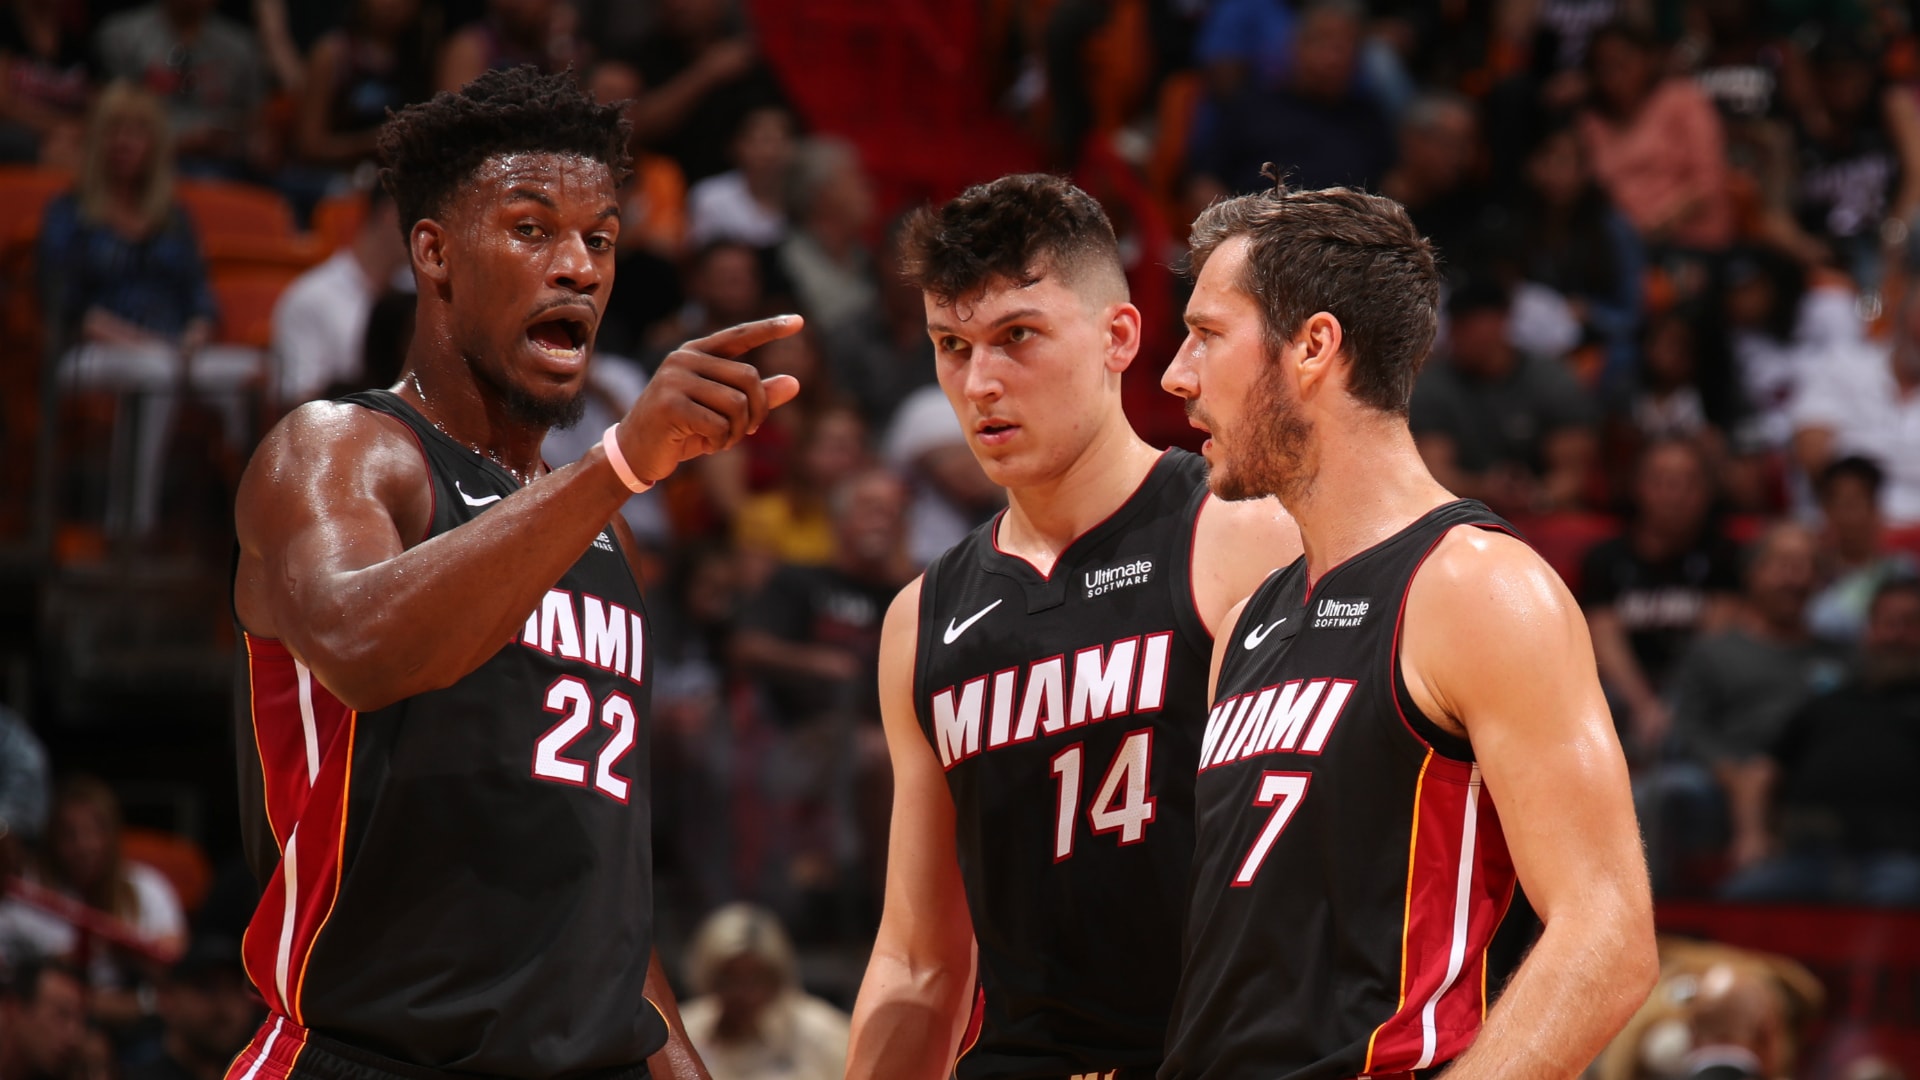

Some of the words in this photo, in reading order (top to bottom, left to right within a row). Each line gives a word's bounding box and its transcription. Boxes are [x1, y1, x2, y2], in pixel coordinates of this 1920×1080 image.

[1085, 560, 1153, 588] Ultimate
[1087, 574, 1149, 598] SOFTWARE
[1314, 617, 1363, 628] SOFTWARE
[1317, 599, 1369, 617] Ultimate
[509, 587, 644, 687] IAMI
[531, 674, 639, 806] 22
[931, 630, 1174, 772] MIAMI
[1197, 677, 1358, 776] MIAMI
[1050, 727, 1157, 864] 14
[1230, 770, 1313, 888] 7
